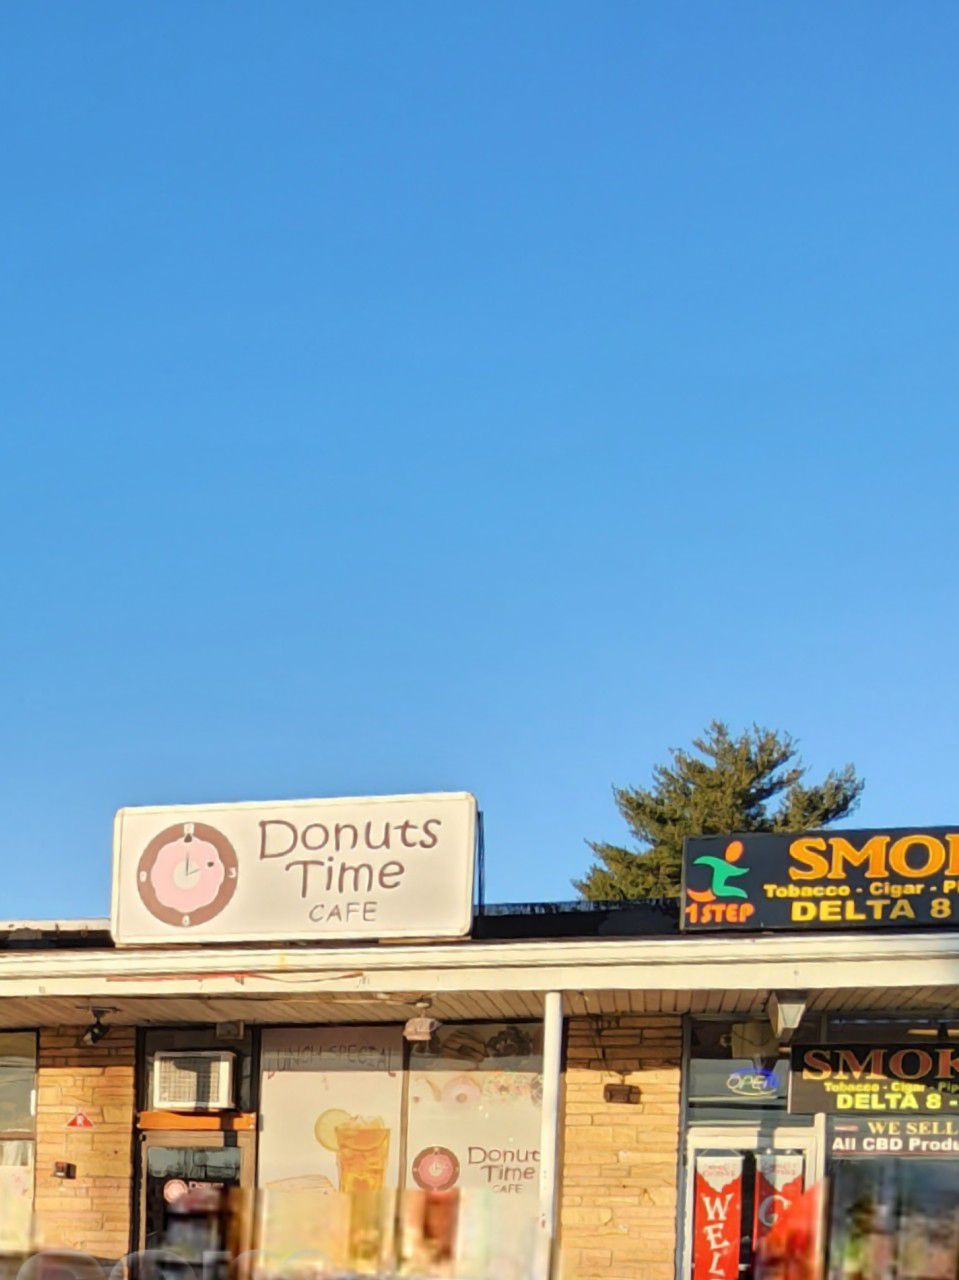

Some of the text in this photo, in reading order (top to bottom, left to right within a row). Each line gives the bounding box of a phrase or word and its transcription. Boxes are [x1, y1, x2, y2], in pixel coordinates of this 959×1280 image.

[258, 818, 442, 859] Donuts
[285, 856, 405, 898] Time
[763, 884, 850, 898] Tobacco
[869, 881, 925, 897] Cigar
[309, 901, 378, 923] CAFE
[791, 898, 951, 921] DELTA 8
[837, 1093, 942, 1109] DELTA 8
[867, 1121, 958, 1134] WE SELL
[832, 1137, 856, 1150] All
[862, 1137, 903, 1150] CBD
[481, 1164, 536, 1182] Time
[493, 1183, 523, 1193] CAFE
